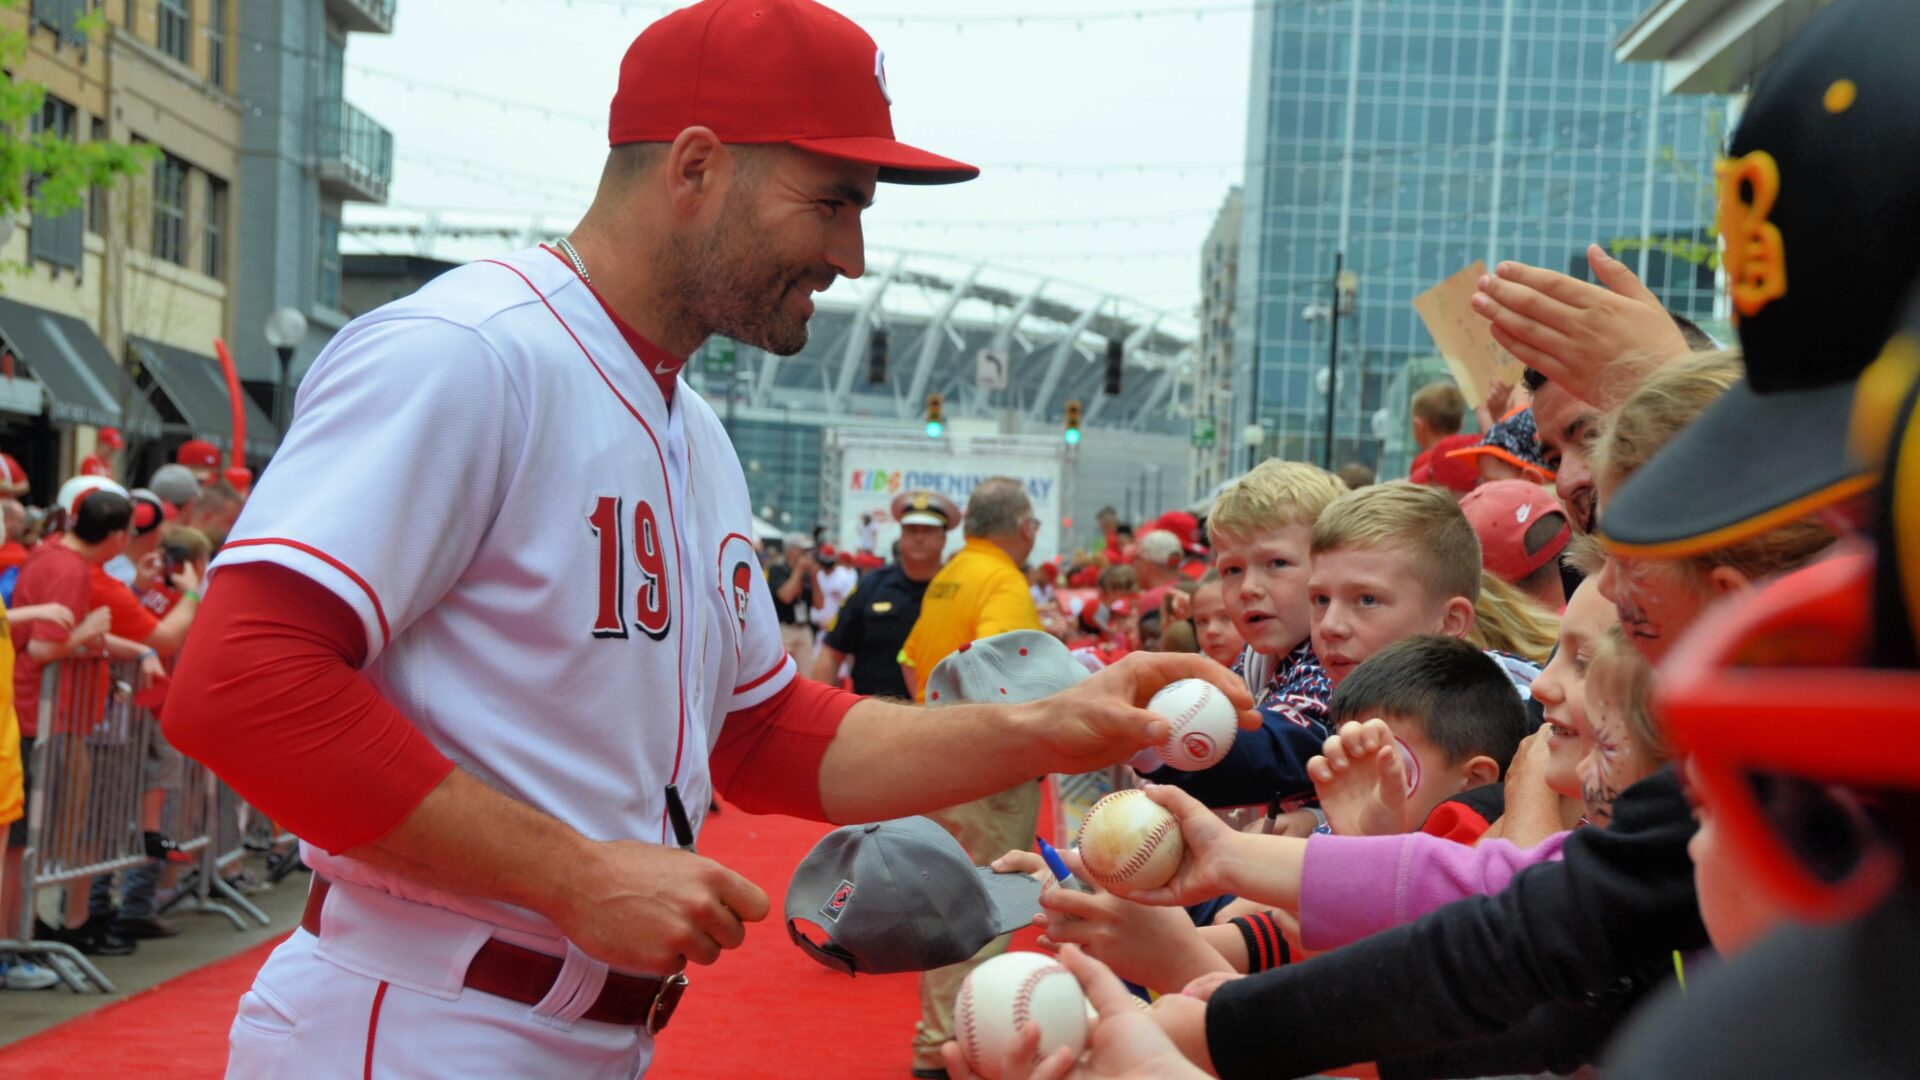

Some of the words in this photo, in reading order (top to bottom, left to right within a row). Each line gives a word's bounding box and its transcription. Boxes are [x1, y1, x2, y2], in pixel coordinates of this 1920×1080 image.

[851, 469, 902, 493] KIDS
[905, 471, 984, 494] OPENIN
[1020, 477, 1053, 498] AY
[586, 496, 672, 641] 19
